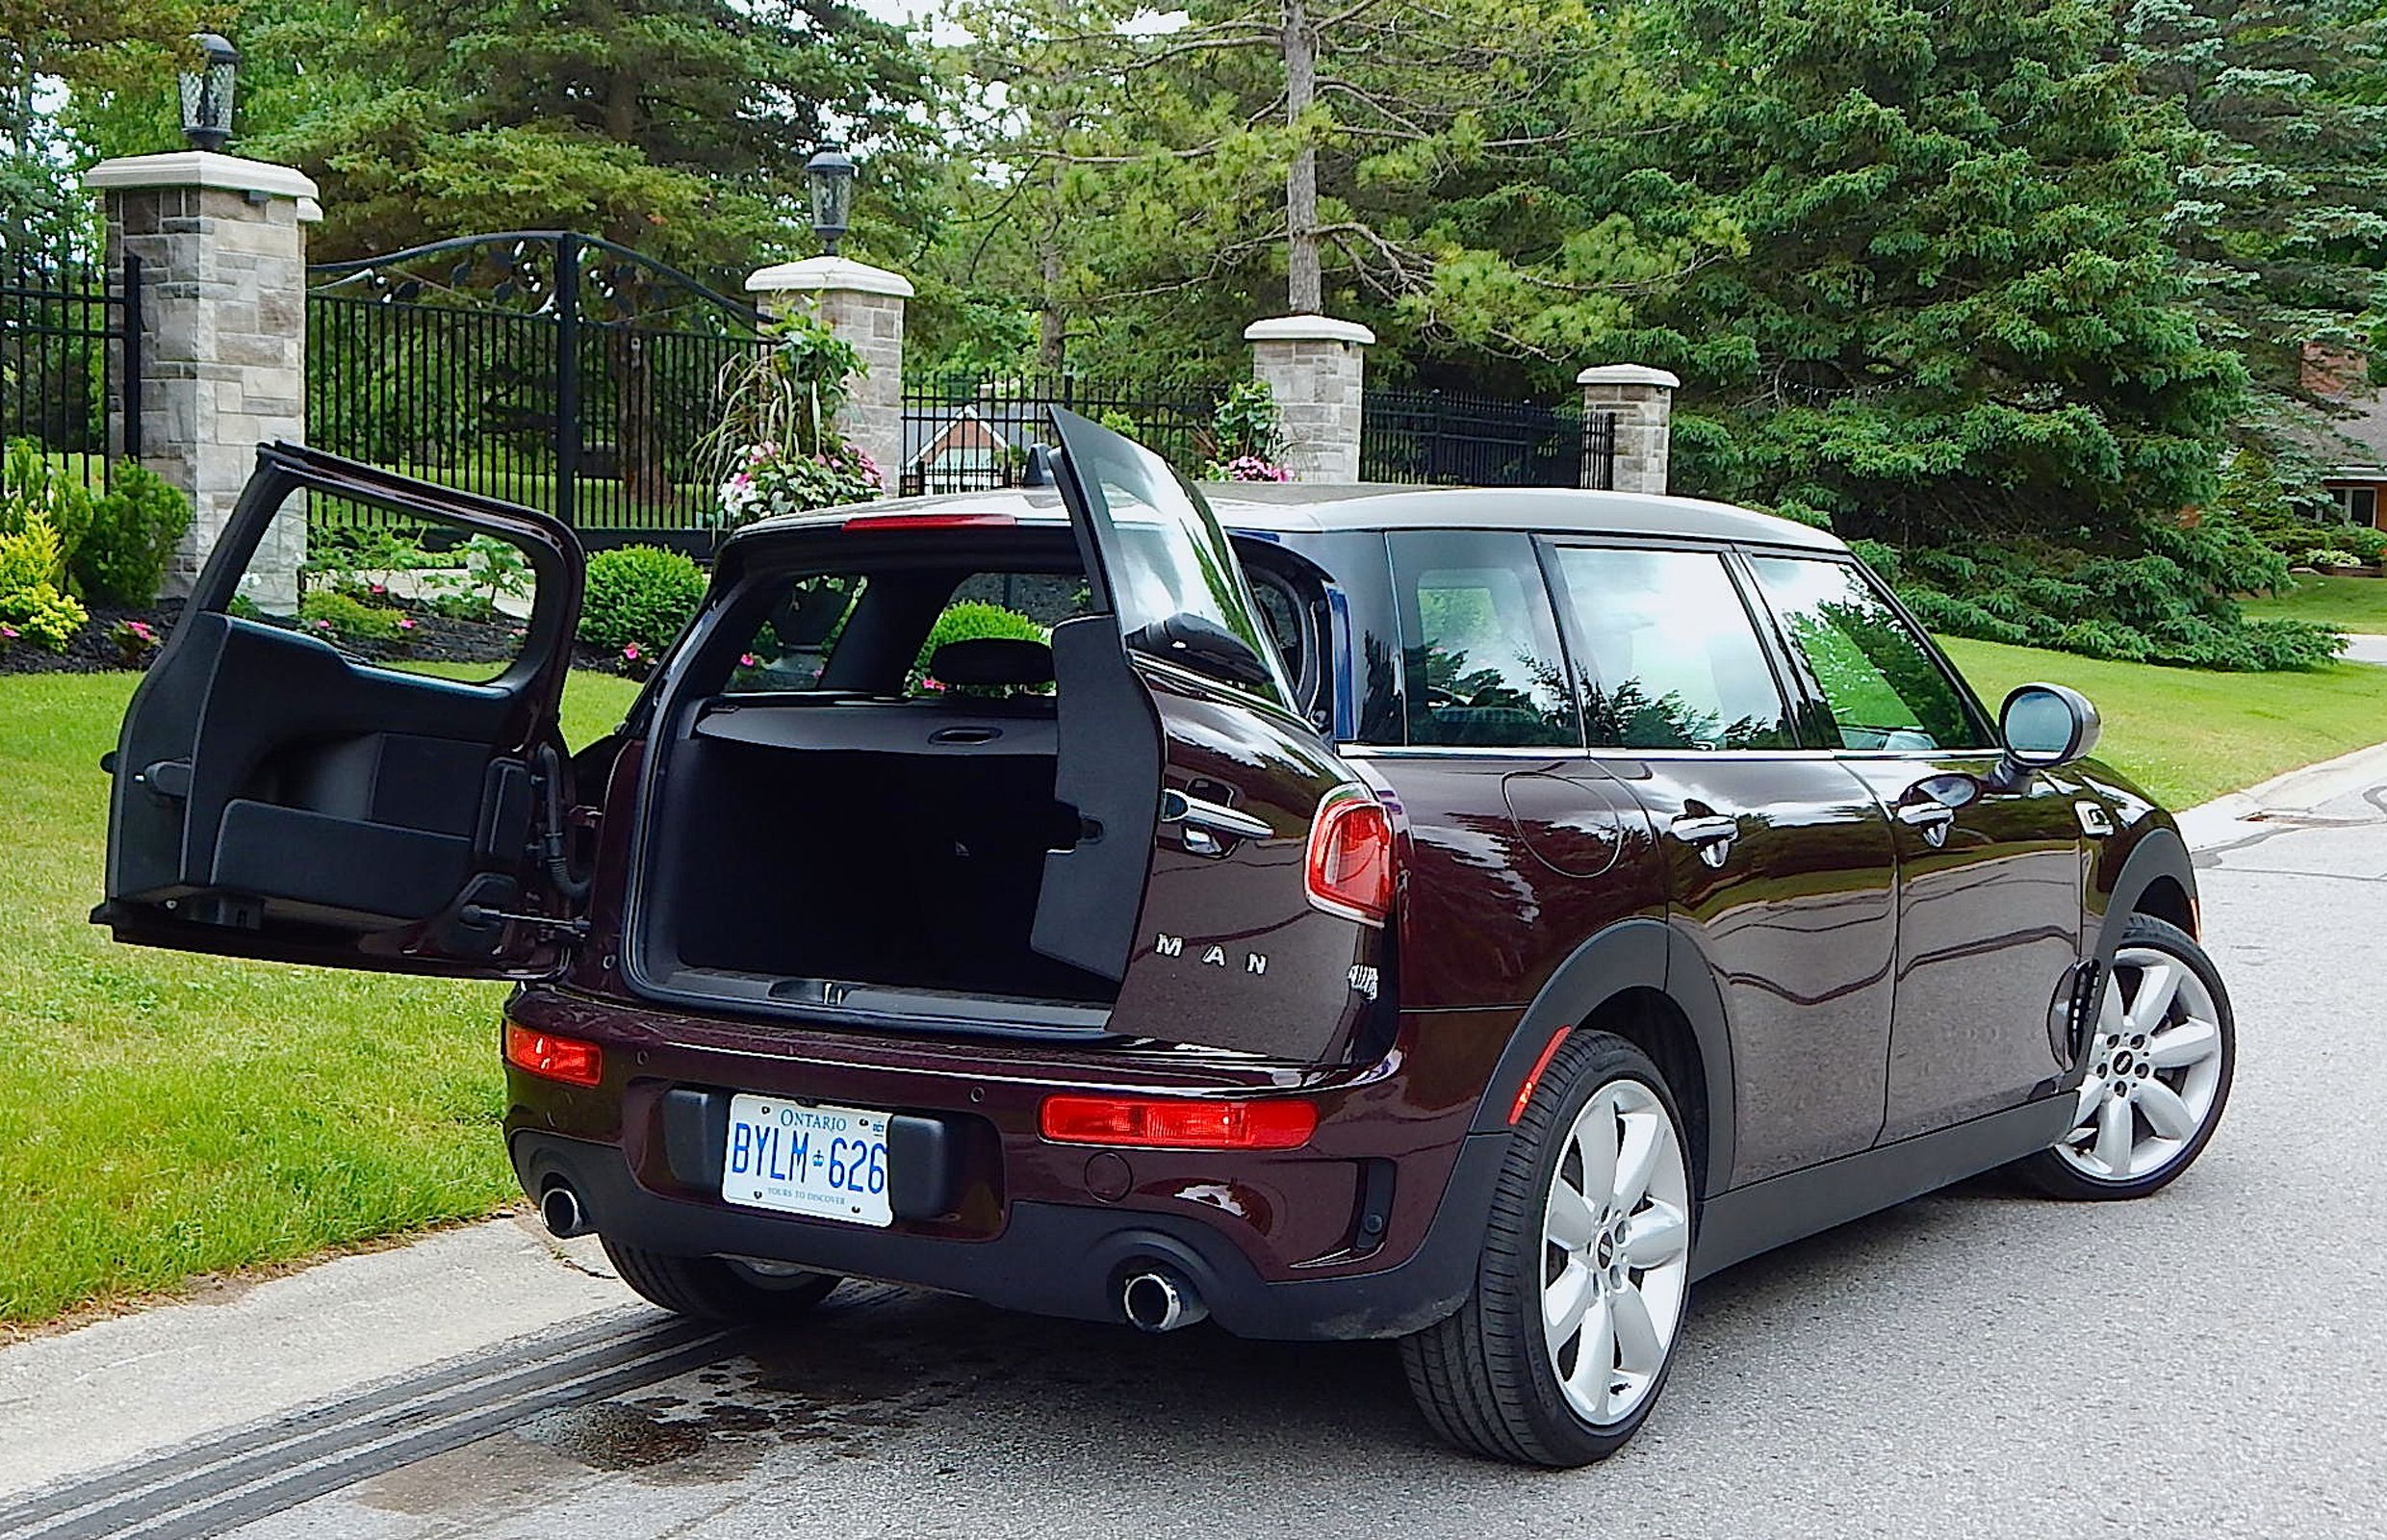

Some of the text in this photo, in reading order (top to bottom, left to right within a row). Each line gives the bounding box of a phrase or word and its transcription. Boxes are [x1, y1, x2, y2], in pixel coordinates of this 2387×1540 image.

[1155, 933, 1267, 974] MAN
[781, 1109, 847, 1132] ONTARIO
[732, 1122, 889, 1194] BYLM 626
